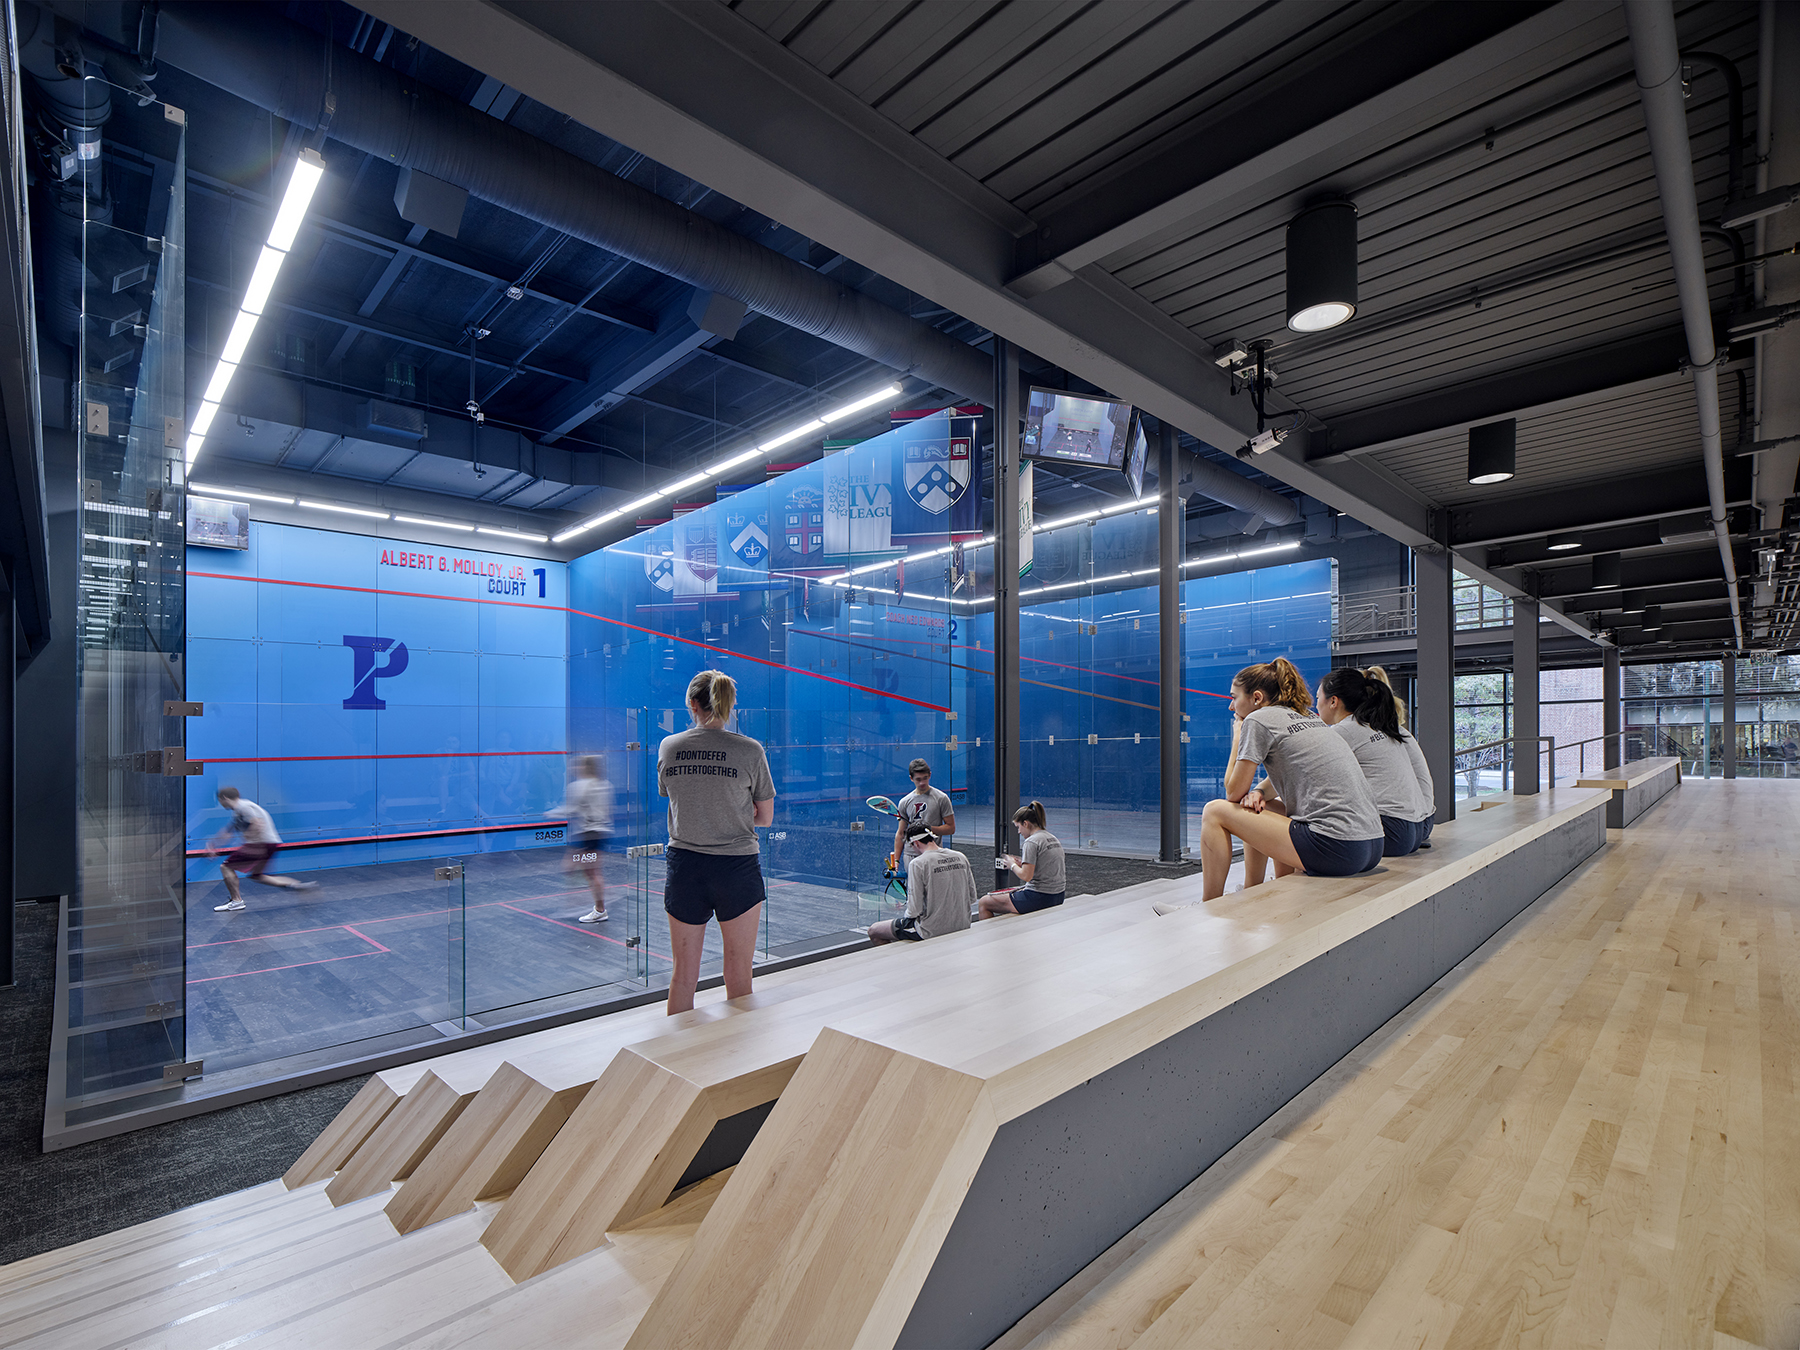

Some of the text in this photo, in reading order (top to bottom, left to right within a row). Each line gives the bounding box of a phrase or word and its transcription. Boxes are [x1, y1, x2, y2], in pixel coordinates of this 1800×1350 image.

[849, 474, 869, 483] THE
[849, 507, 892, 519] LEAGU
[381, 549, 434, 570] ALBERT
[438, 556, 450, 572] G.
[508, 565, 527, 580] JR.
[487, 578, 526, 596] COURT
[886, 612, 905, 623] COACH
[947, 619, 958, 640] 2
[675, 750, 727, 761] #DONTDEFER
[665, 765, 738, 778] #BETTERTOGETHER
[544, 830, 564, 840] ASB
[580, 852, 598, 861] ASB
